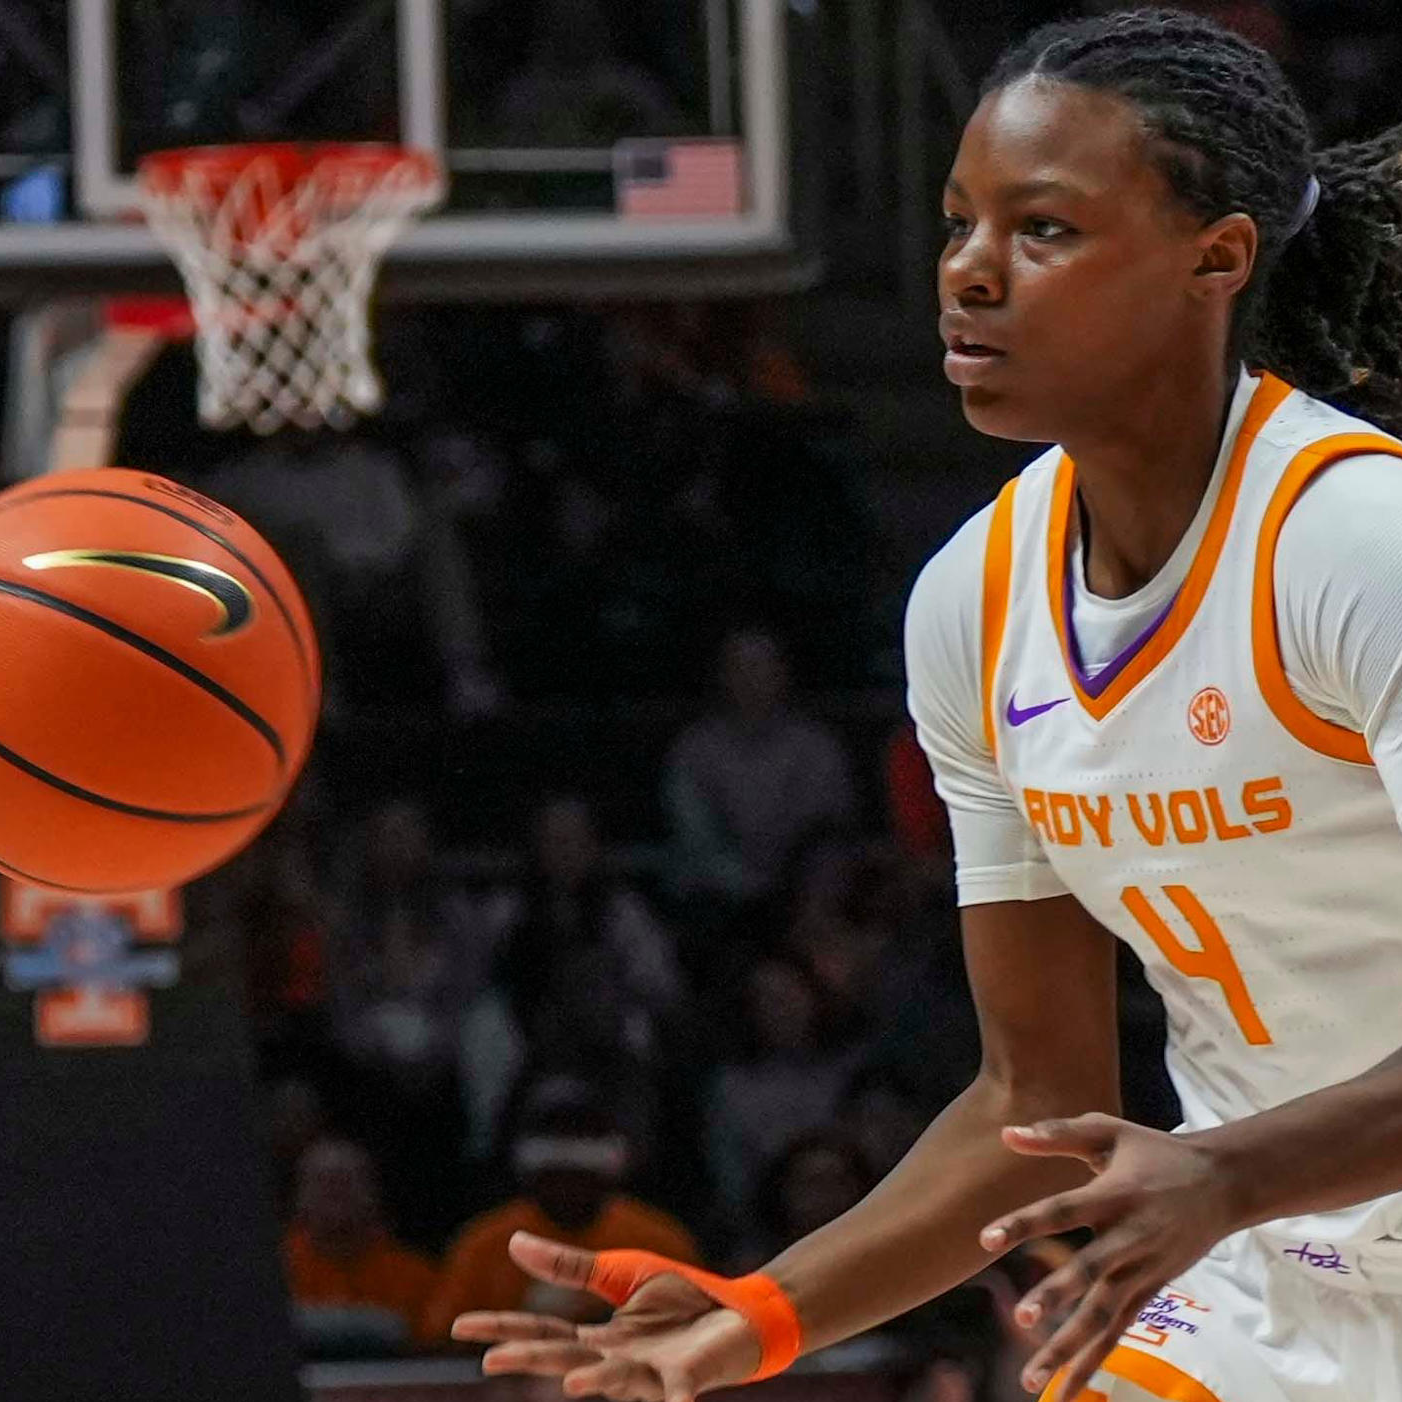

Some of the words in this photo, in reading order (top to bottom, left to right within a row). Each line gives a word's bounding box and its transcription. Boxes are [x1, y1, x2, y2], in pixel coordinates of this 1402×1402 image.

[1190, 690, 1229, 742] SEC
[1022, 786, 1115, 848] ADY
[1125, 775, 1293, 848] VOLS
[1120, 884, 1273, 1046] 4
